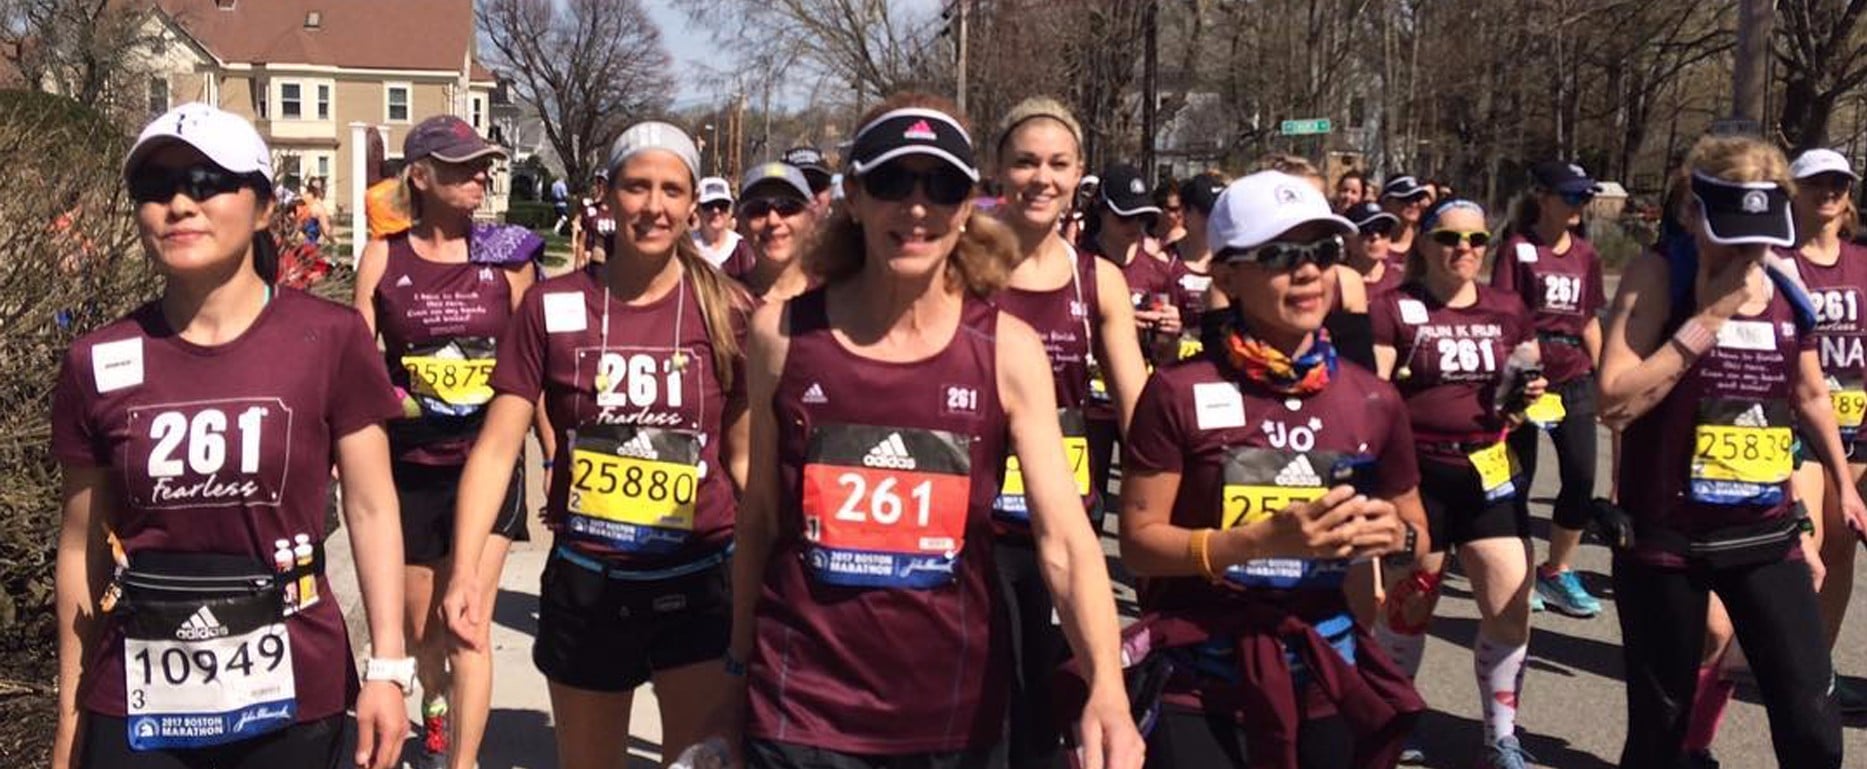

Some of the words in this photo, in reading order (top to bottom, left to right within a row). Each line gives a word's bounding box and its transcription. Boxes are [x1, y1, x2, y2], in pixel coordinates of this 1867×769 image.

[1545, 275, 1581, 303] 261
[1810, 290, 1858, 321] 261
[1438, 338, 1496, 372] 261
[597, 353, 683, 407] 261
[947, 387, 977, 409] 261
[597, 407, 682, 425] Fearless
[148, 406, 263, 477] 261
[1268, 422, 1315, 452] JO
[1698, 432, 1792, 461] 25839
[863, 455, 916, 469] adidas
[152, 474, 259, 502] Fearless
[576, 459, 693, 506] 25880
[835, 473, 932, 527] 261
[830, 562, 894, 576] MARATHON
[176, 626, 229, 640] adidas
[134, 634, 285, 685] 10949
[132, 689, 145, 709] 3
[161, 718, 183, 727] 2017
[184, 718, 223, 727] BOSTON
[162, 727, 224, 737] MARATHON
